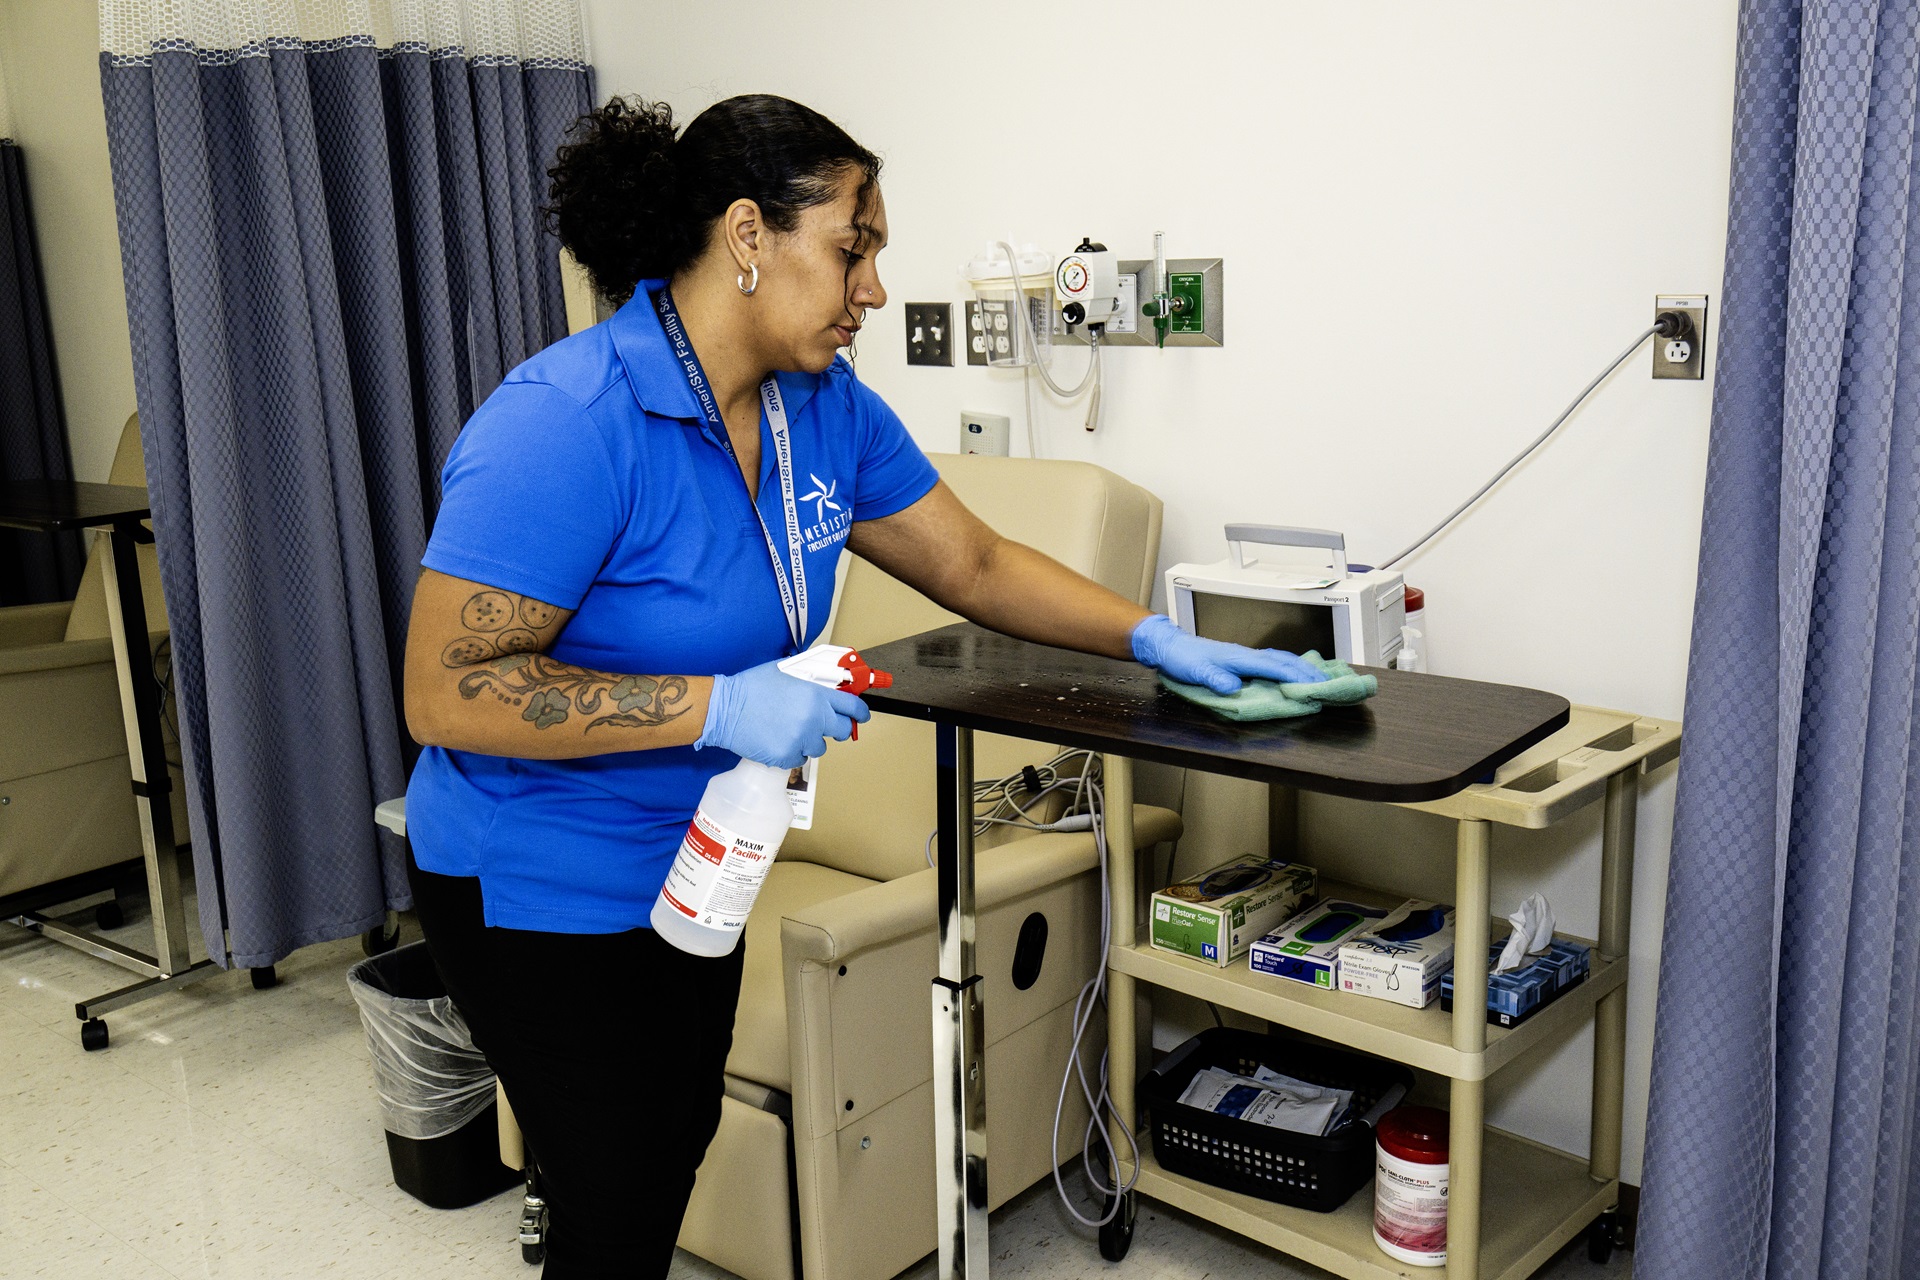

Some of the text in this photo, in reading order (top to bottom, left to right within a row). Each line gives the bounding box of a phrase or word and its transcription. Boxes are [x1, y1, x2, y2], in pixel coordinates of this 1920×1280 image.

[664, 313, 689, 358] Facility
[684, 360, 718, 422] AmeriStar
[735, 838, 764, 852] MAXIM
[1246, 900, 1267, 914] Restore
[1268, 891, 1284, 904] Sense
[1172, 906, 1196, 920] Restore
[1197, 914, 1216, 926] Sense
[1204, 946, 1214, 958] M
[1264, 954, 1284, 962] FitGuard
[1320, 972, 1326, 982] L
[1344, 968, 1378, 979] POWDER-FREE
